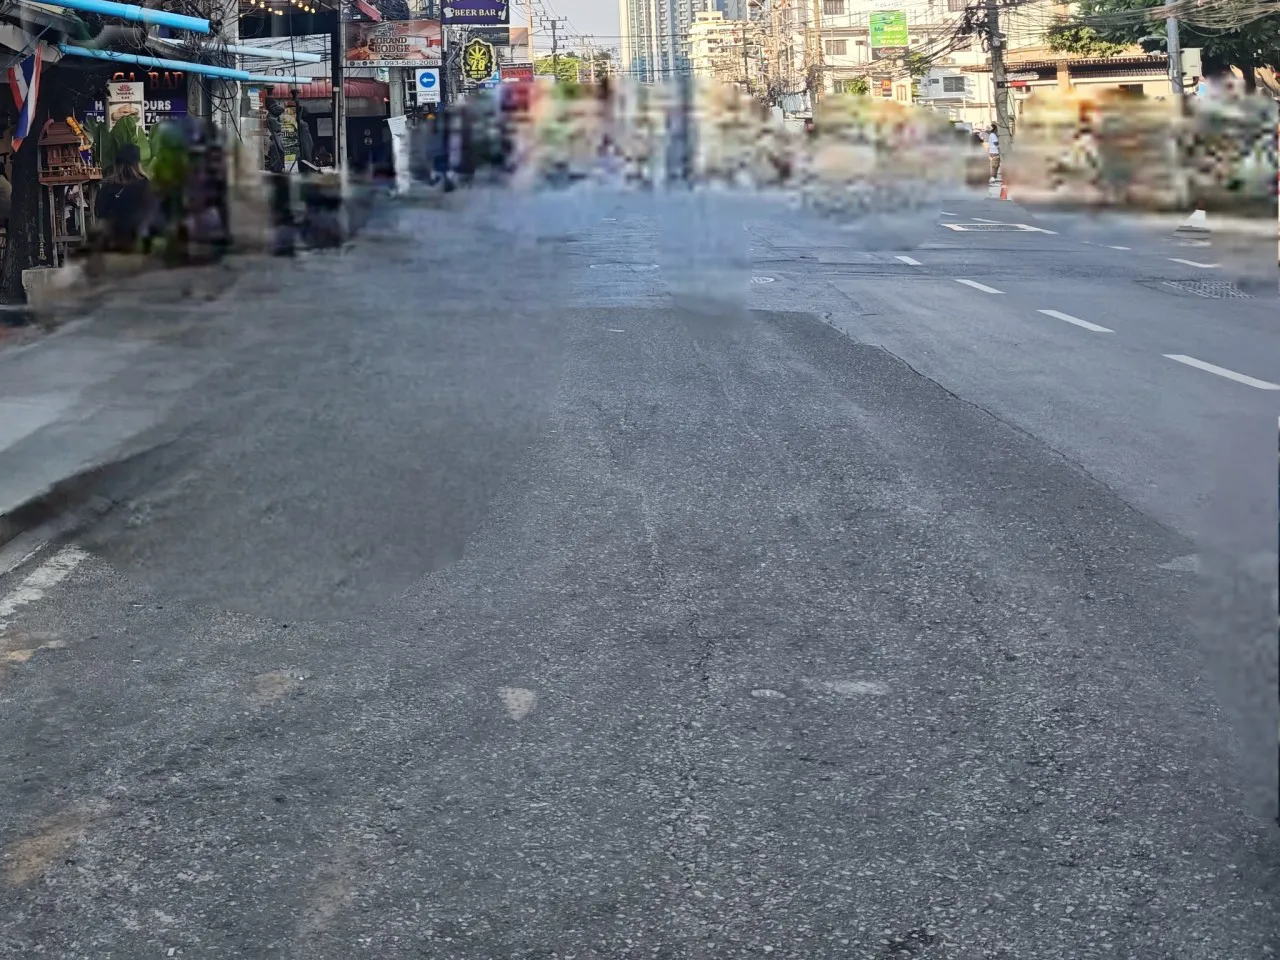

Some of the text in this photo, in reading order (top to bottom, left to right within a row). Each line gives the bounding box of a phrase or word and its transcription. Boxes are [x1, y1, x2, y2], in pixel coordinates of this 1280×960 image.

[454, 8, 496, 17] BEER BAR
[376, 36, 408, 44] GRAND
[374, 44, 411, 53] LODGE
[471, 60, 486, 71] 28
[142, 100, 172, 111] OURS
